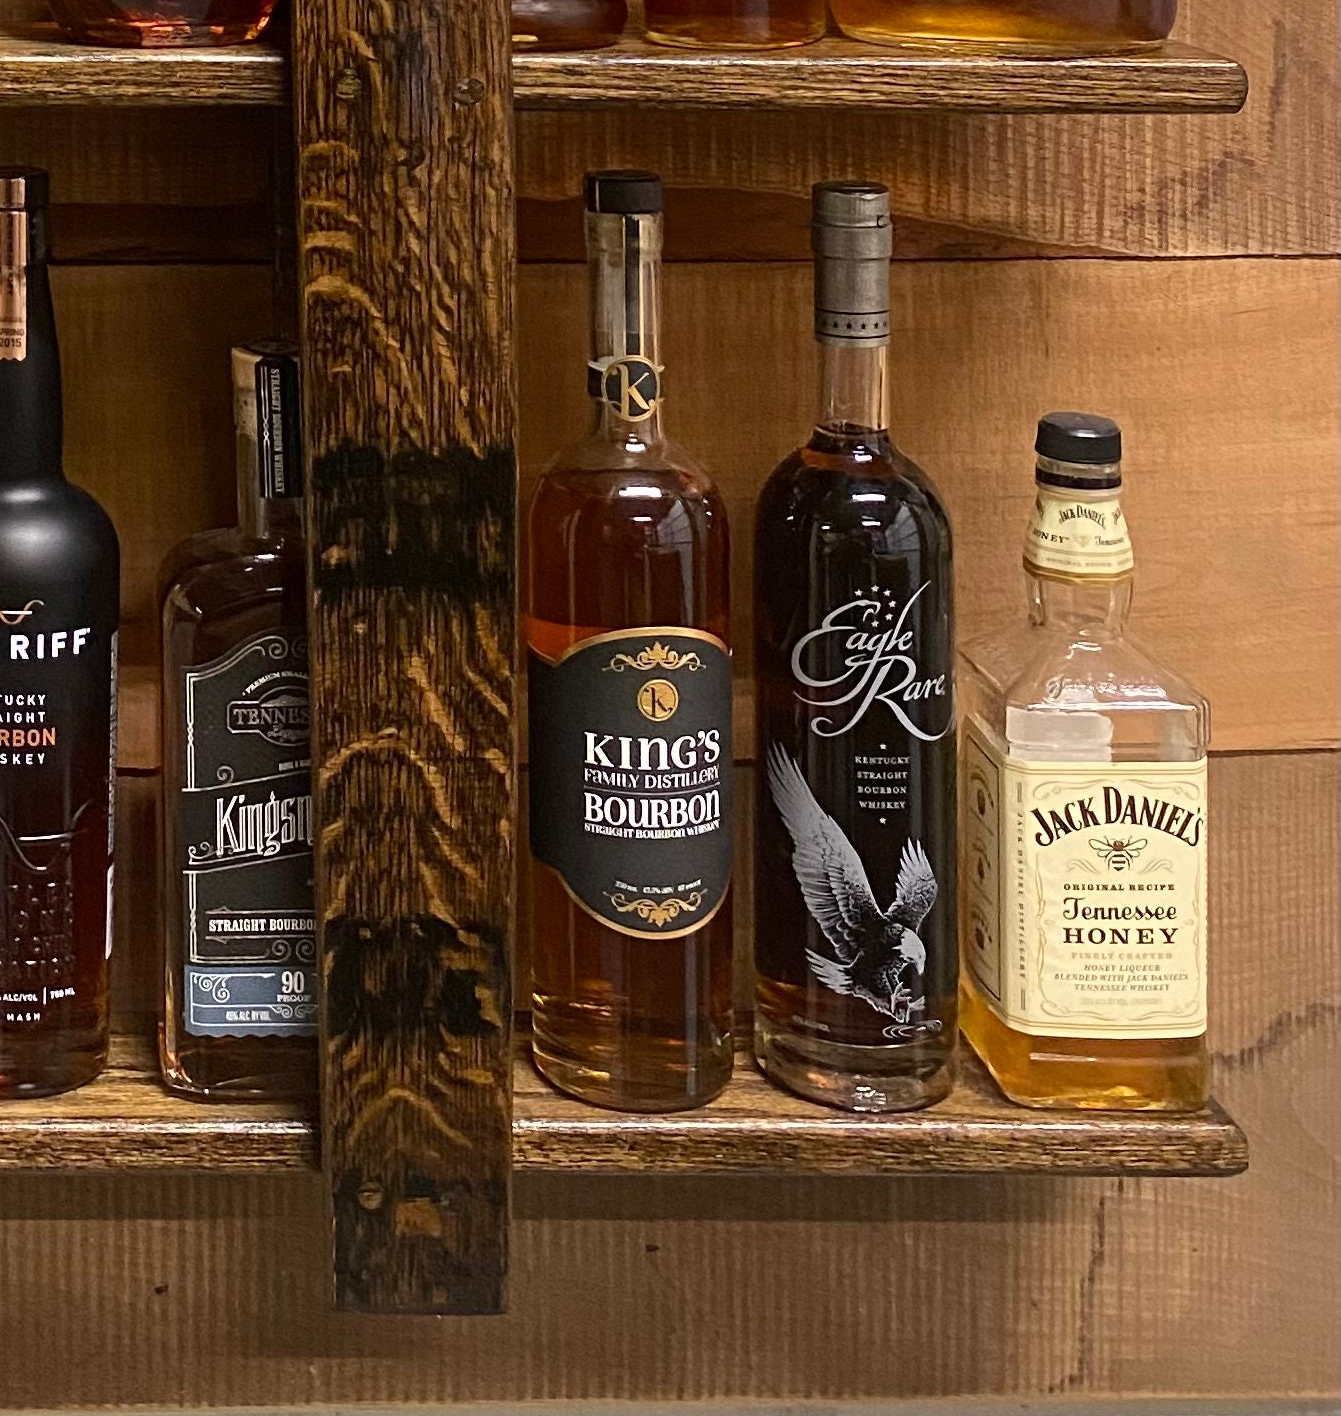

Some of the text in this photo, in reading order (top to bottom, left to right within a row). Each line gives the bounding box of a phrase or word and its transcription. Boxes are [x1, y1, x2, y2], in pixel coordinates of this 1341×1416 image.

[10, 628, 87, 660] RIFF
[791, 579, 932, 707] Eagle
[810, 654, 956, 742] Rare
[854, 756, 910, 764] KENTUCKY
[857, 771, 908, 780] STRAIGHT
[857, 785, 907, 794] BOURBON
[584, 789, 721, 829] BOURBON
[859, 800, 906, 809] WHISKEY
[1030, 786, 1204, 847] JACK DANIEL'S
[1063, 883, 1124, 891] ORIGINAL
[1062, 896, 1177, 921] Tennessee
[208, 918, 266, 932] STRAIGHT
[1062, 927, 1179, 945] HONEY
[281, 971, 304, 994] 90
[7, 1013, 40, 1021] MASH
